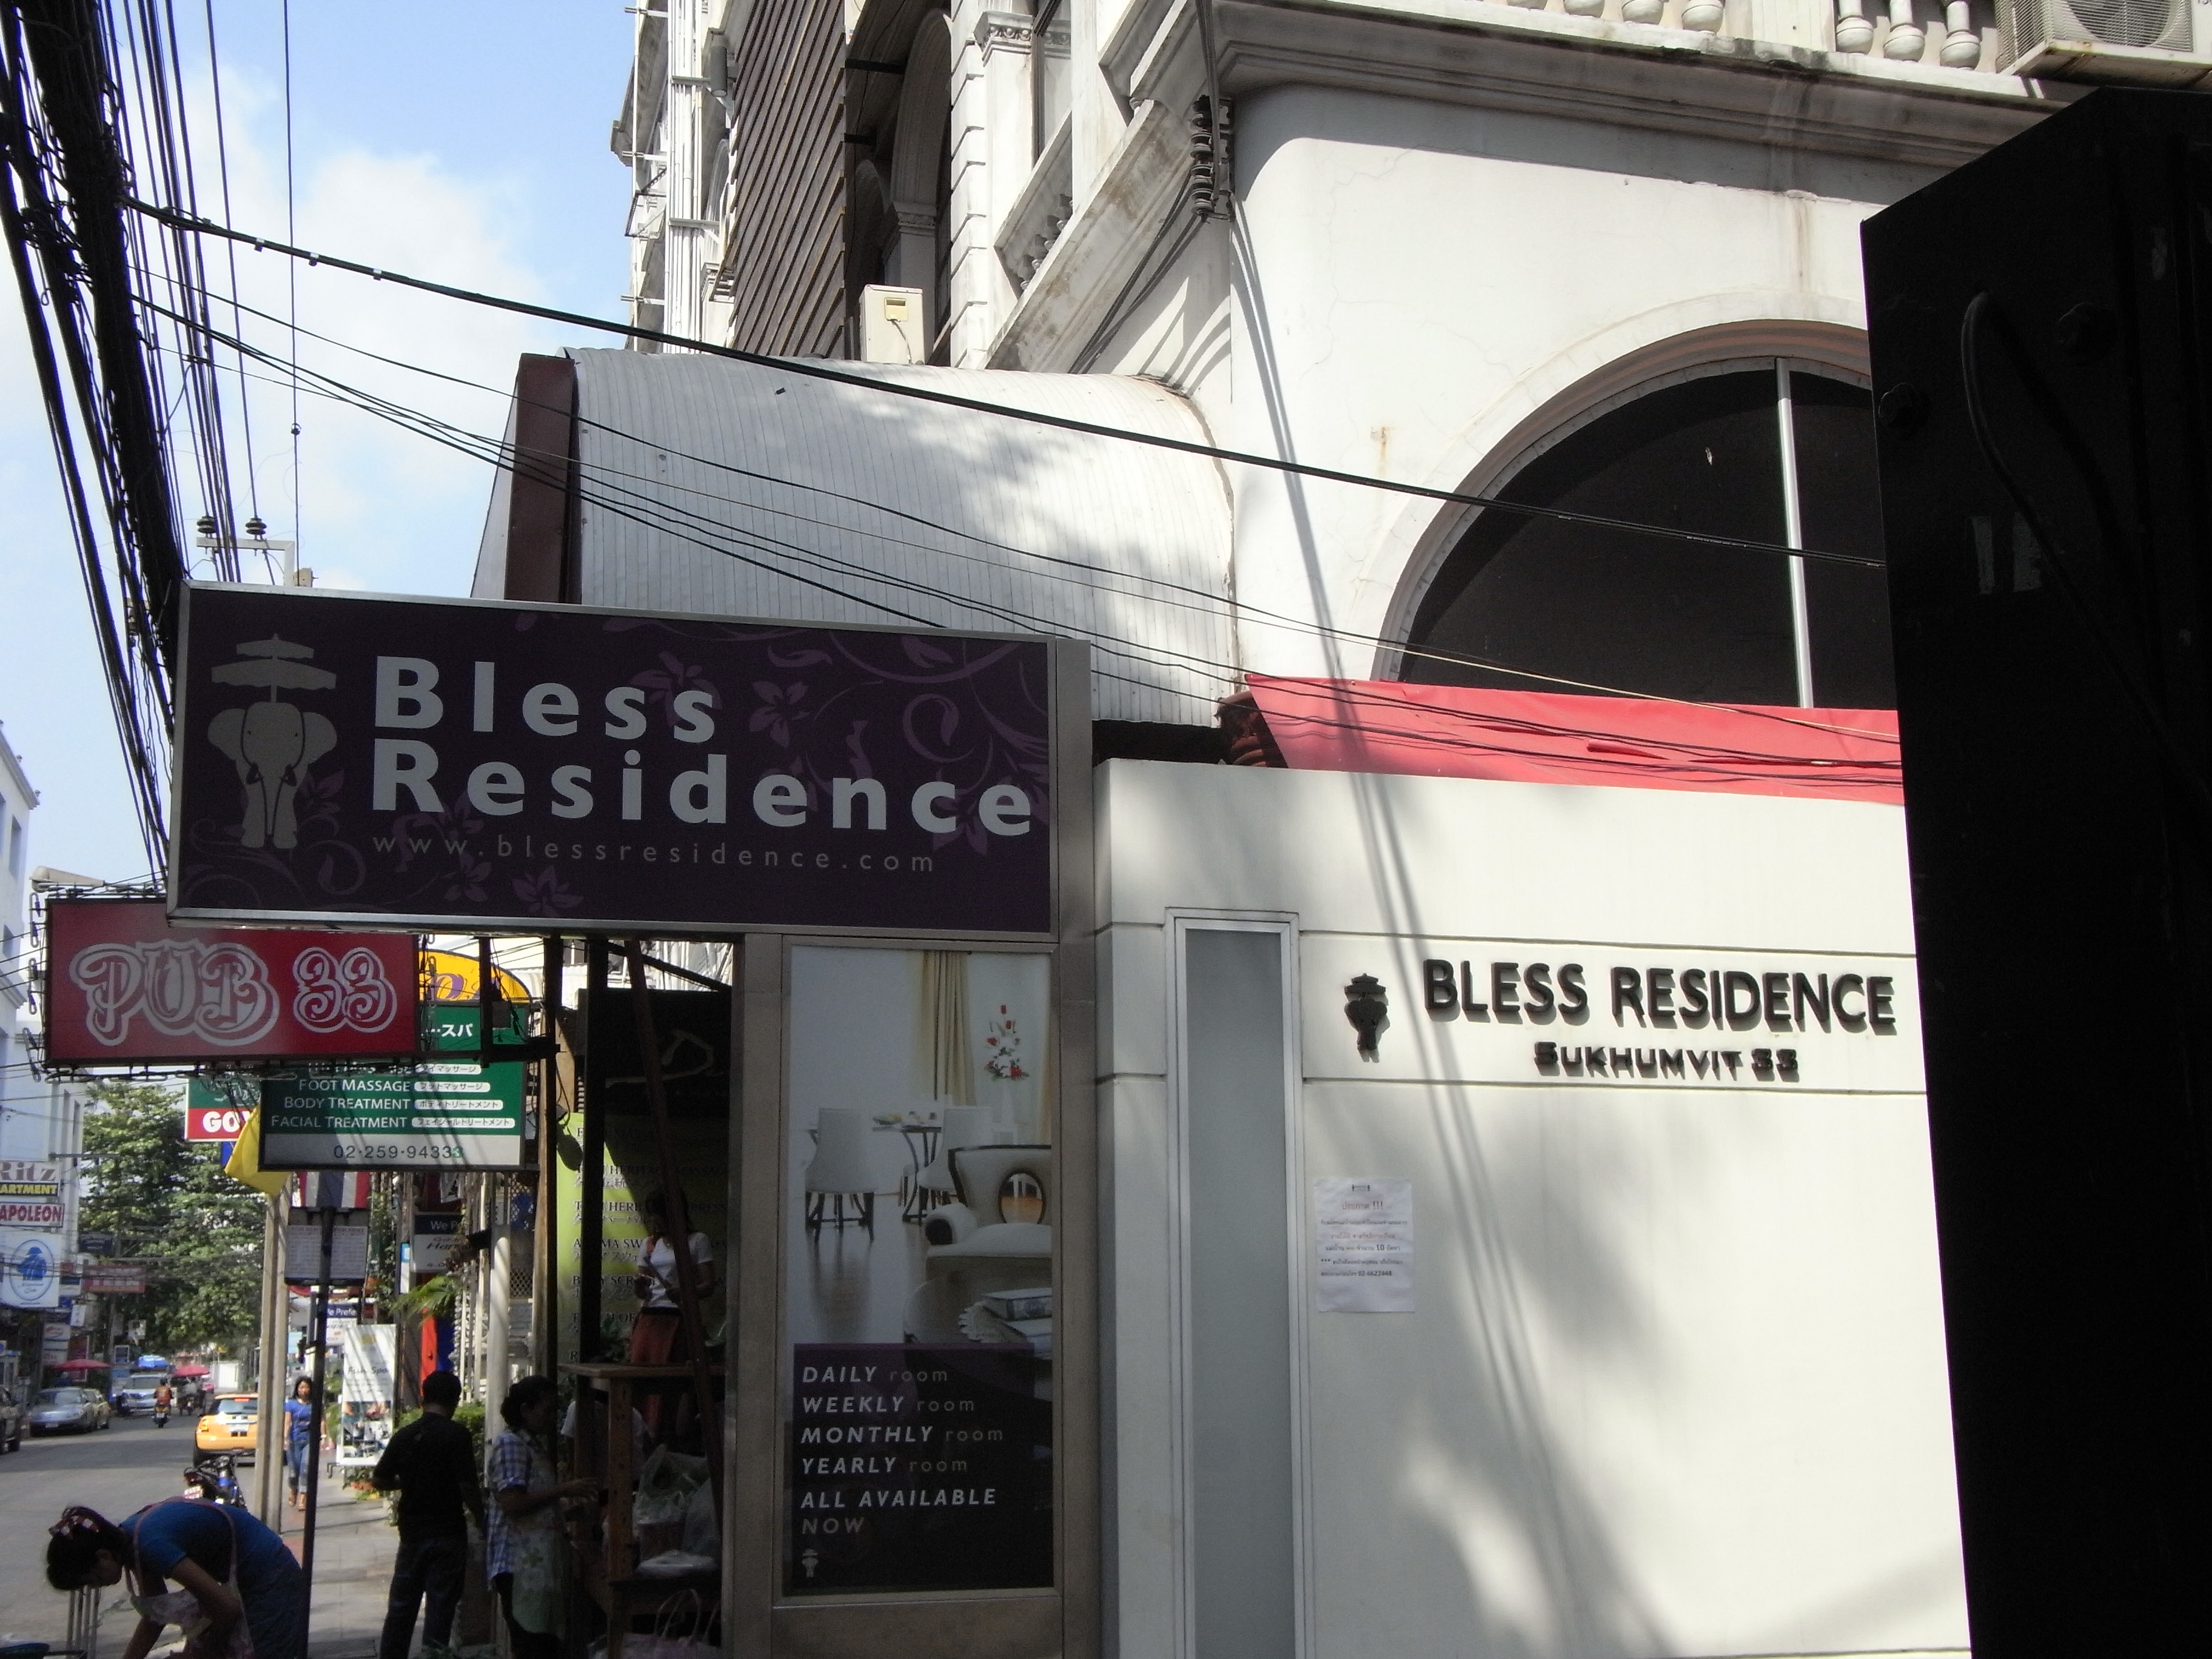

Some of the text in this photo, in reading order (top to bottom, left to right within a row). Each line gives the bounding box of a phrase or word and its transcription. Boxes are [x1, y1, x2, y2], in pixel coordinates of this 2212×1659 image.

[375, 655, 716, 743] Bless
[372, 738, 1031, 836] Residence
[374, 834, 933, 872] www.blessresidence.com
[70, 938, 397, 1047] PUB 33
[1423, 959, 1896, 1026] BLESS RESIDENCE
[1534, 1041, 1741, 1074] SUKHUMVIT
[299, 1079, 338, 1090] FOOT
[342, 1080, 411, 1091] MASSAGE
[284, 1097, 325, 1108] BODY
[328, 1098, 411, 1109] TREATMENT
[271, 1116, 321, 1127] FACIAL
[325, 1116, 408, 1128] TREATMENT
[0, 1184, 58, 1194] ARTMENT
[0, 1204, 61, 1222] APOLEON
[574, 1238, 619, 1248] AMA
[802, 1366, 948, 1383] DAILY room
[802, 1396, 975, 1413] WEEKLY room
[800, 1426, 1004, 1444] MONTHLY room
[802, 1457, 968, 1475] YEARLY room
[800, 1489, 997, 1509] ALL AVAILABLE
[801, 1517, 865, 1535] NOW
